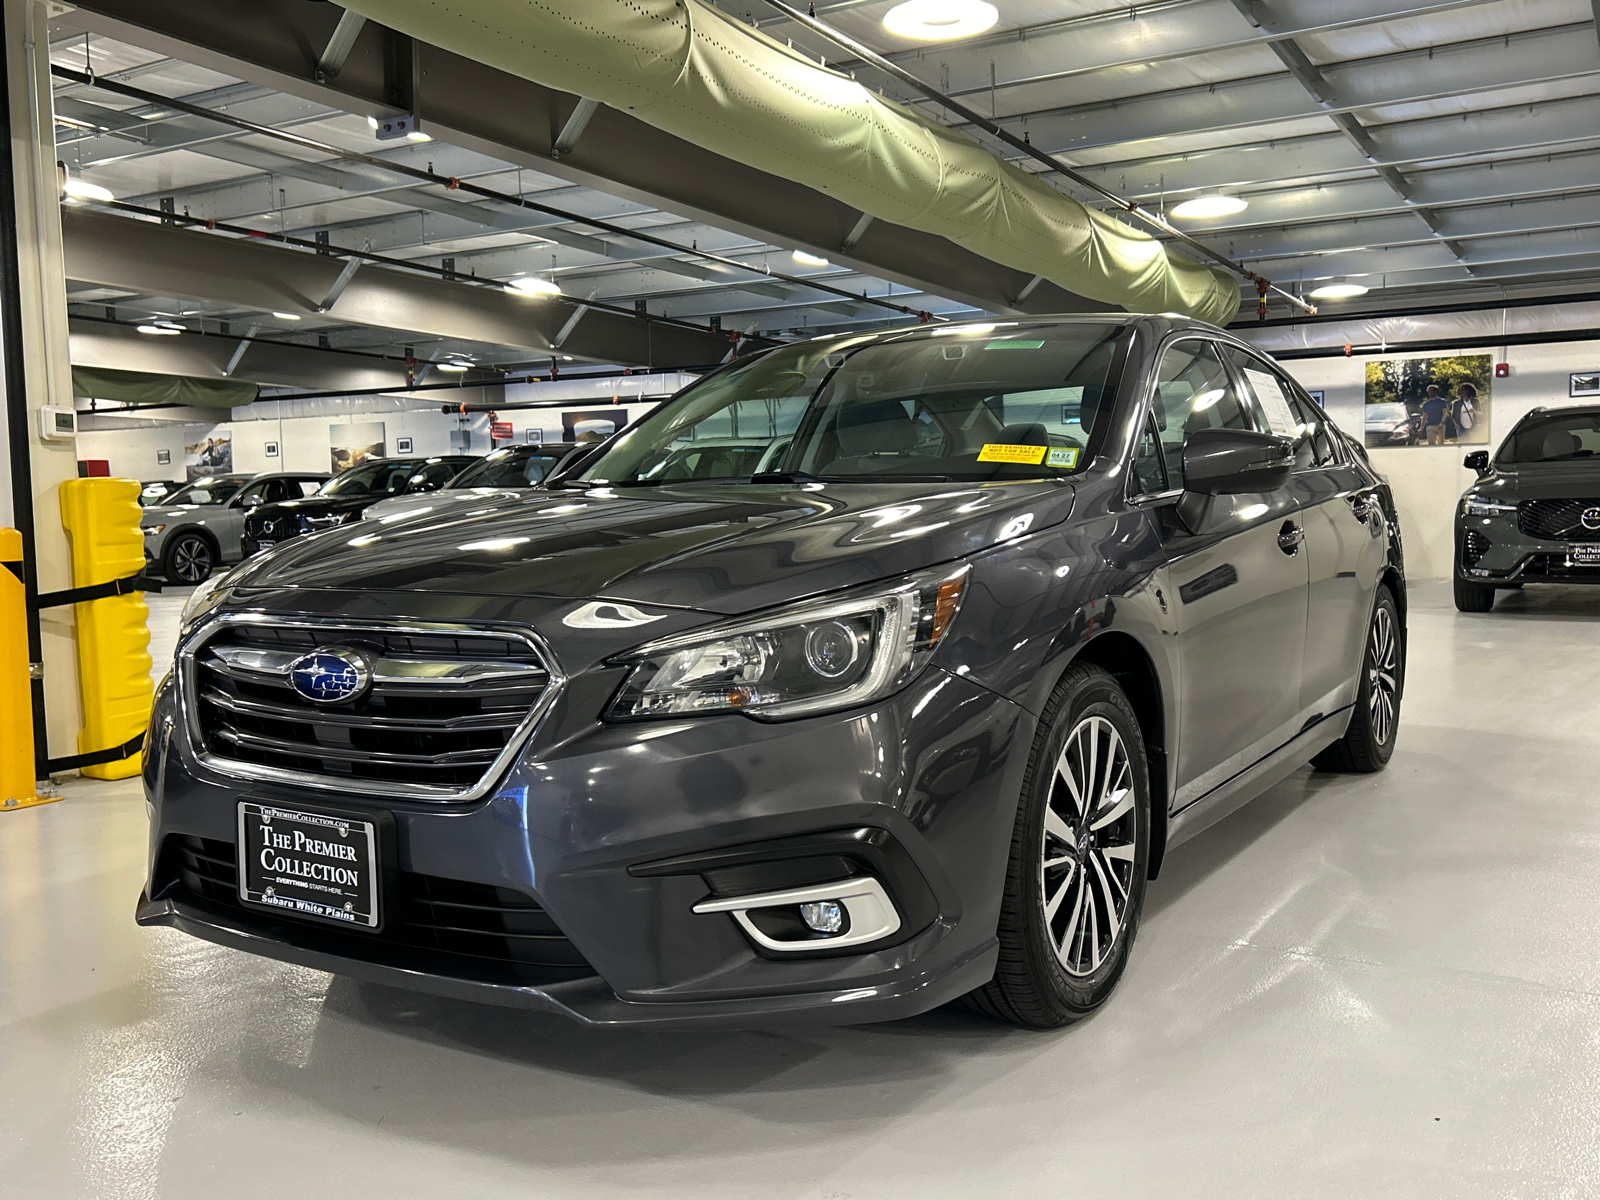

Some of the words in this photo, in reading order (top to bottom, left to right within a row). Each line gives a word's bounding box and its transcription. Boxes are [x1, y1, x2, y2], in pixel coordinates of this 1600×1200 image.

[259, 825, 292, 850] THE
[293, 830, 358, 862] PREMIER
[260, 848, 359, 887] COLLECTION
[275, 876, 309, 889] EVERYTHING
[308, 882, 329, 893] STARTS
[261, 894, 294, 908] Subaru
[296, 900, 324, 914] White
[325, 907, 355, 921] Plains
